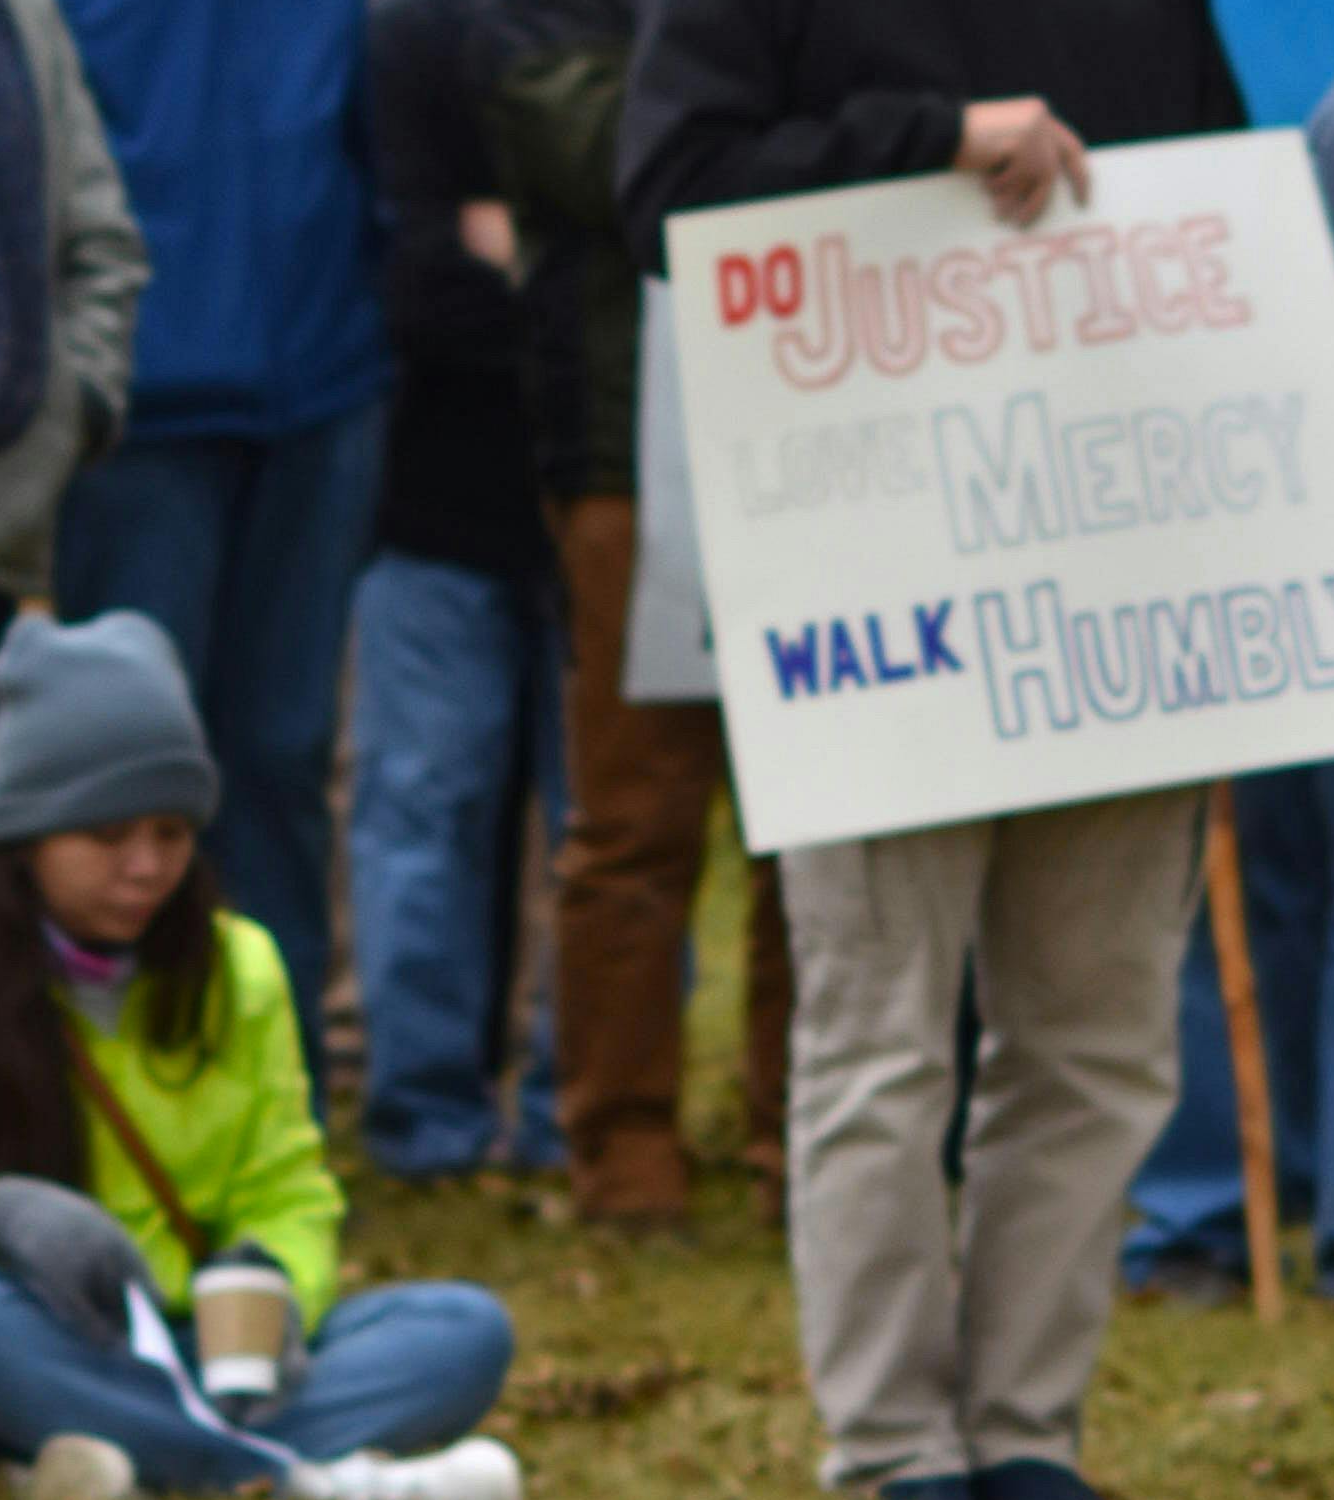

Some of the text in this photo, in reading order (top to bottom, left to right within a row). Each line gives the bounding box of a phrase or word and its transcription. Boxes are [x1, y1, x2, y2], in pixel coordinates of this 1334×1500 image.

[715, 212, 1251, 391] DO JUSTICE
[932, 386, 1309, 557] MERCY
[764, 597, 965, 701] WALK
